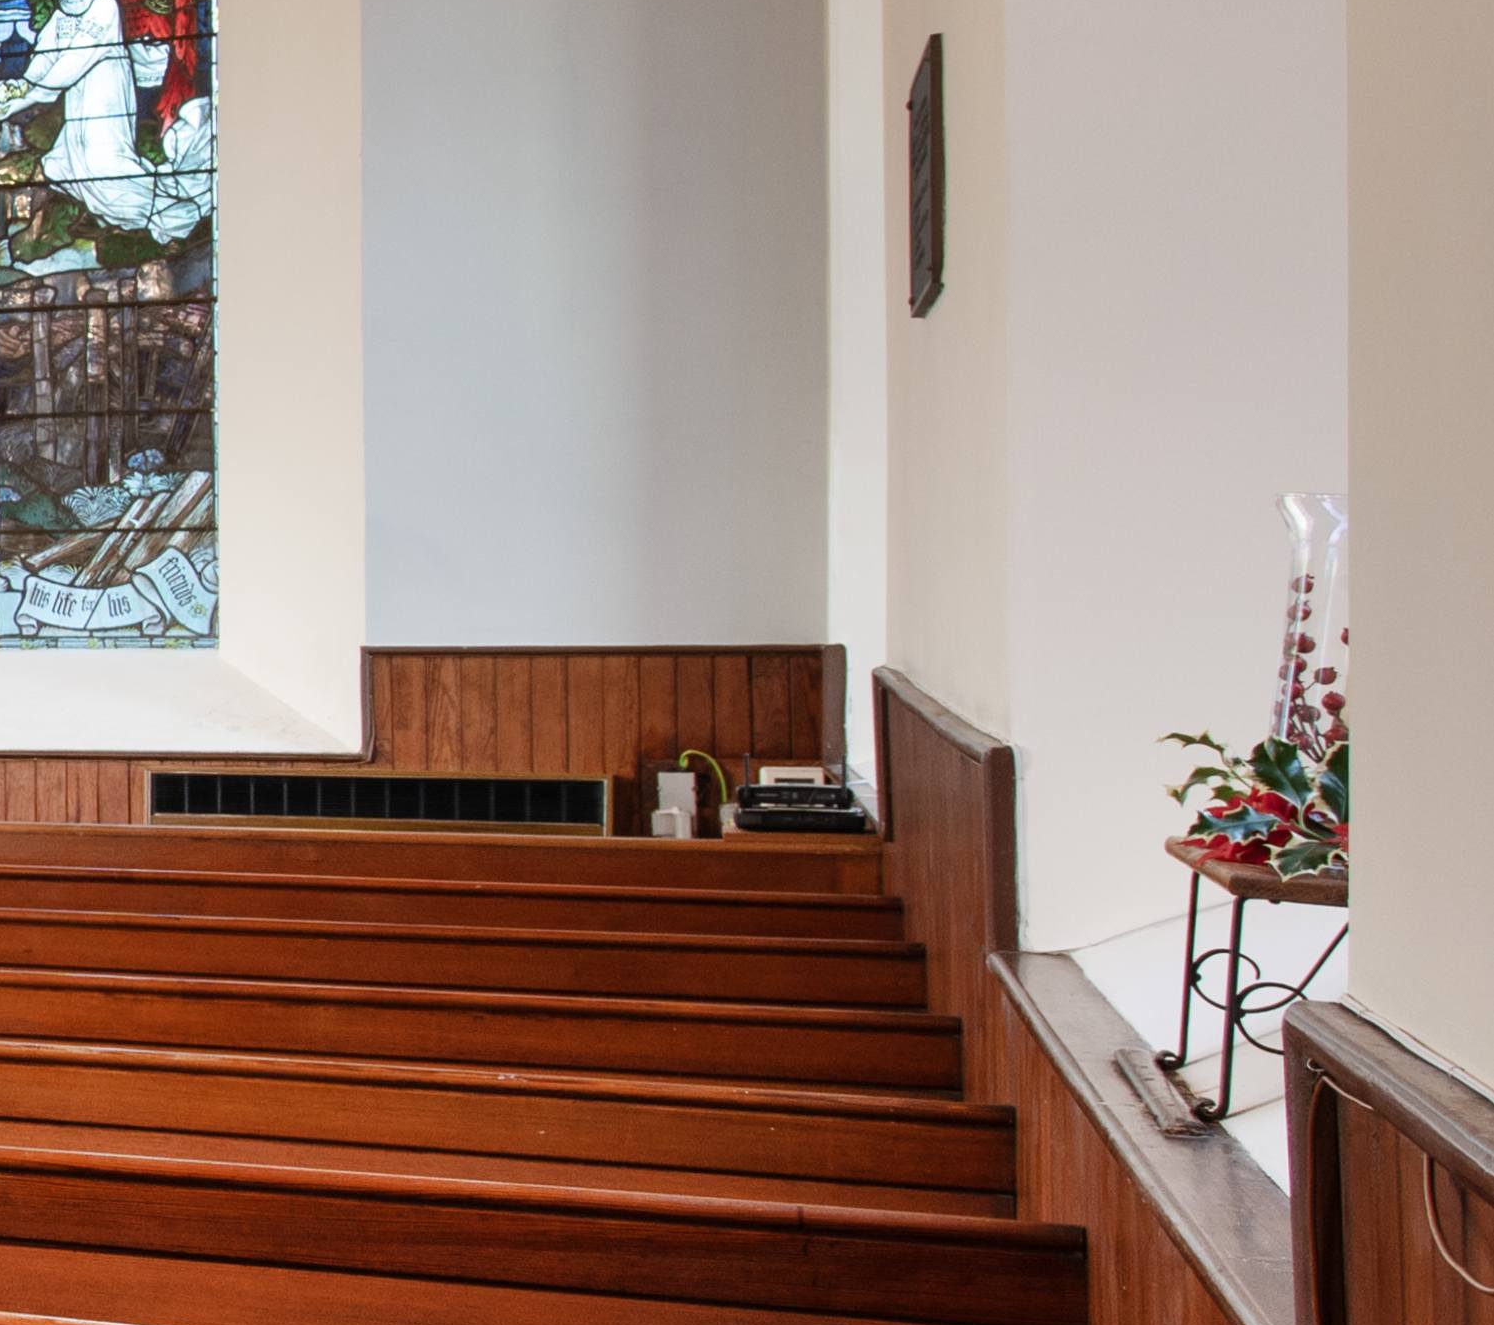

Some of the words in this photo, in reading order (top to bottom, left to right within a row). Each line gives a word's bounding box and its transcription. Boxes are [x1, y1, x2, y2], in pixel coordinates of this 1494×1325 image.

[28, 582, 50, 608] his
[52, 589, 78, 618] life
[107, 592, 132, 618] his
[158, 556, 198, 608] friends
